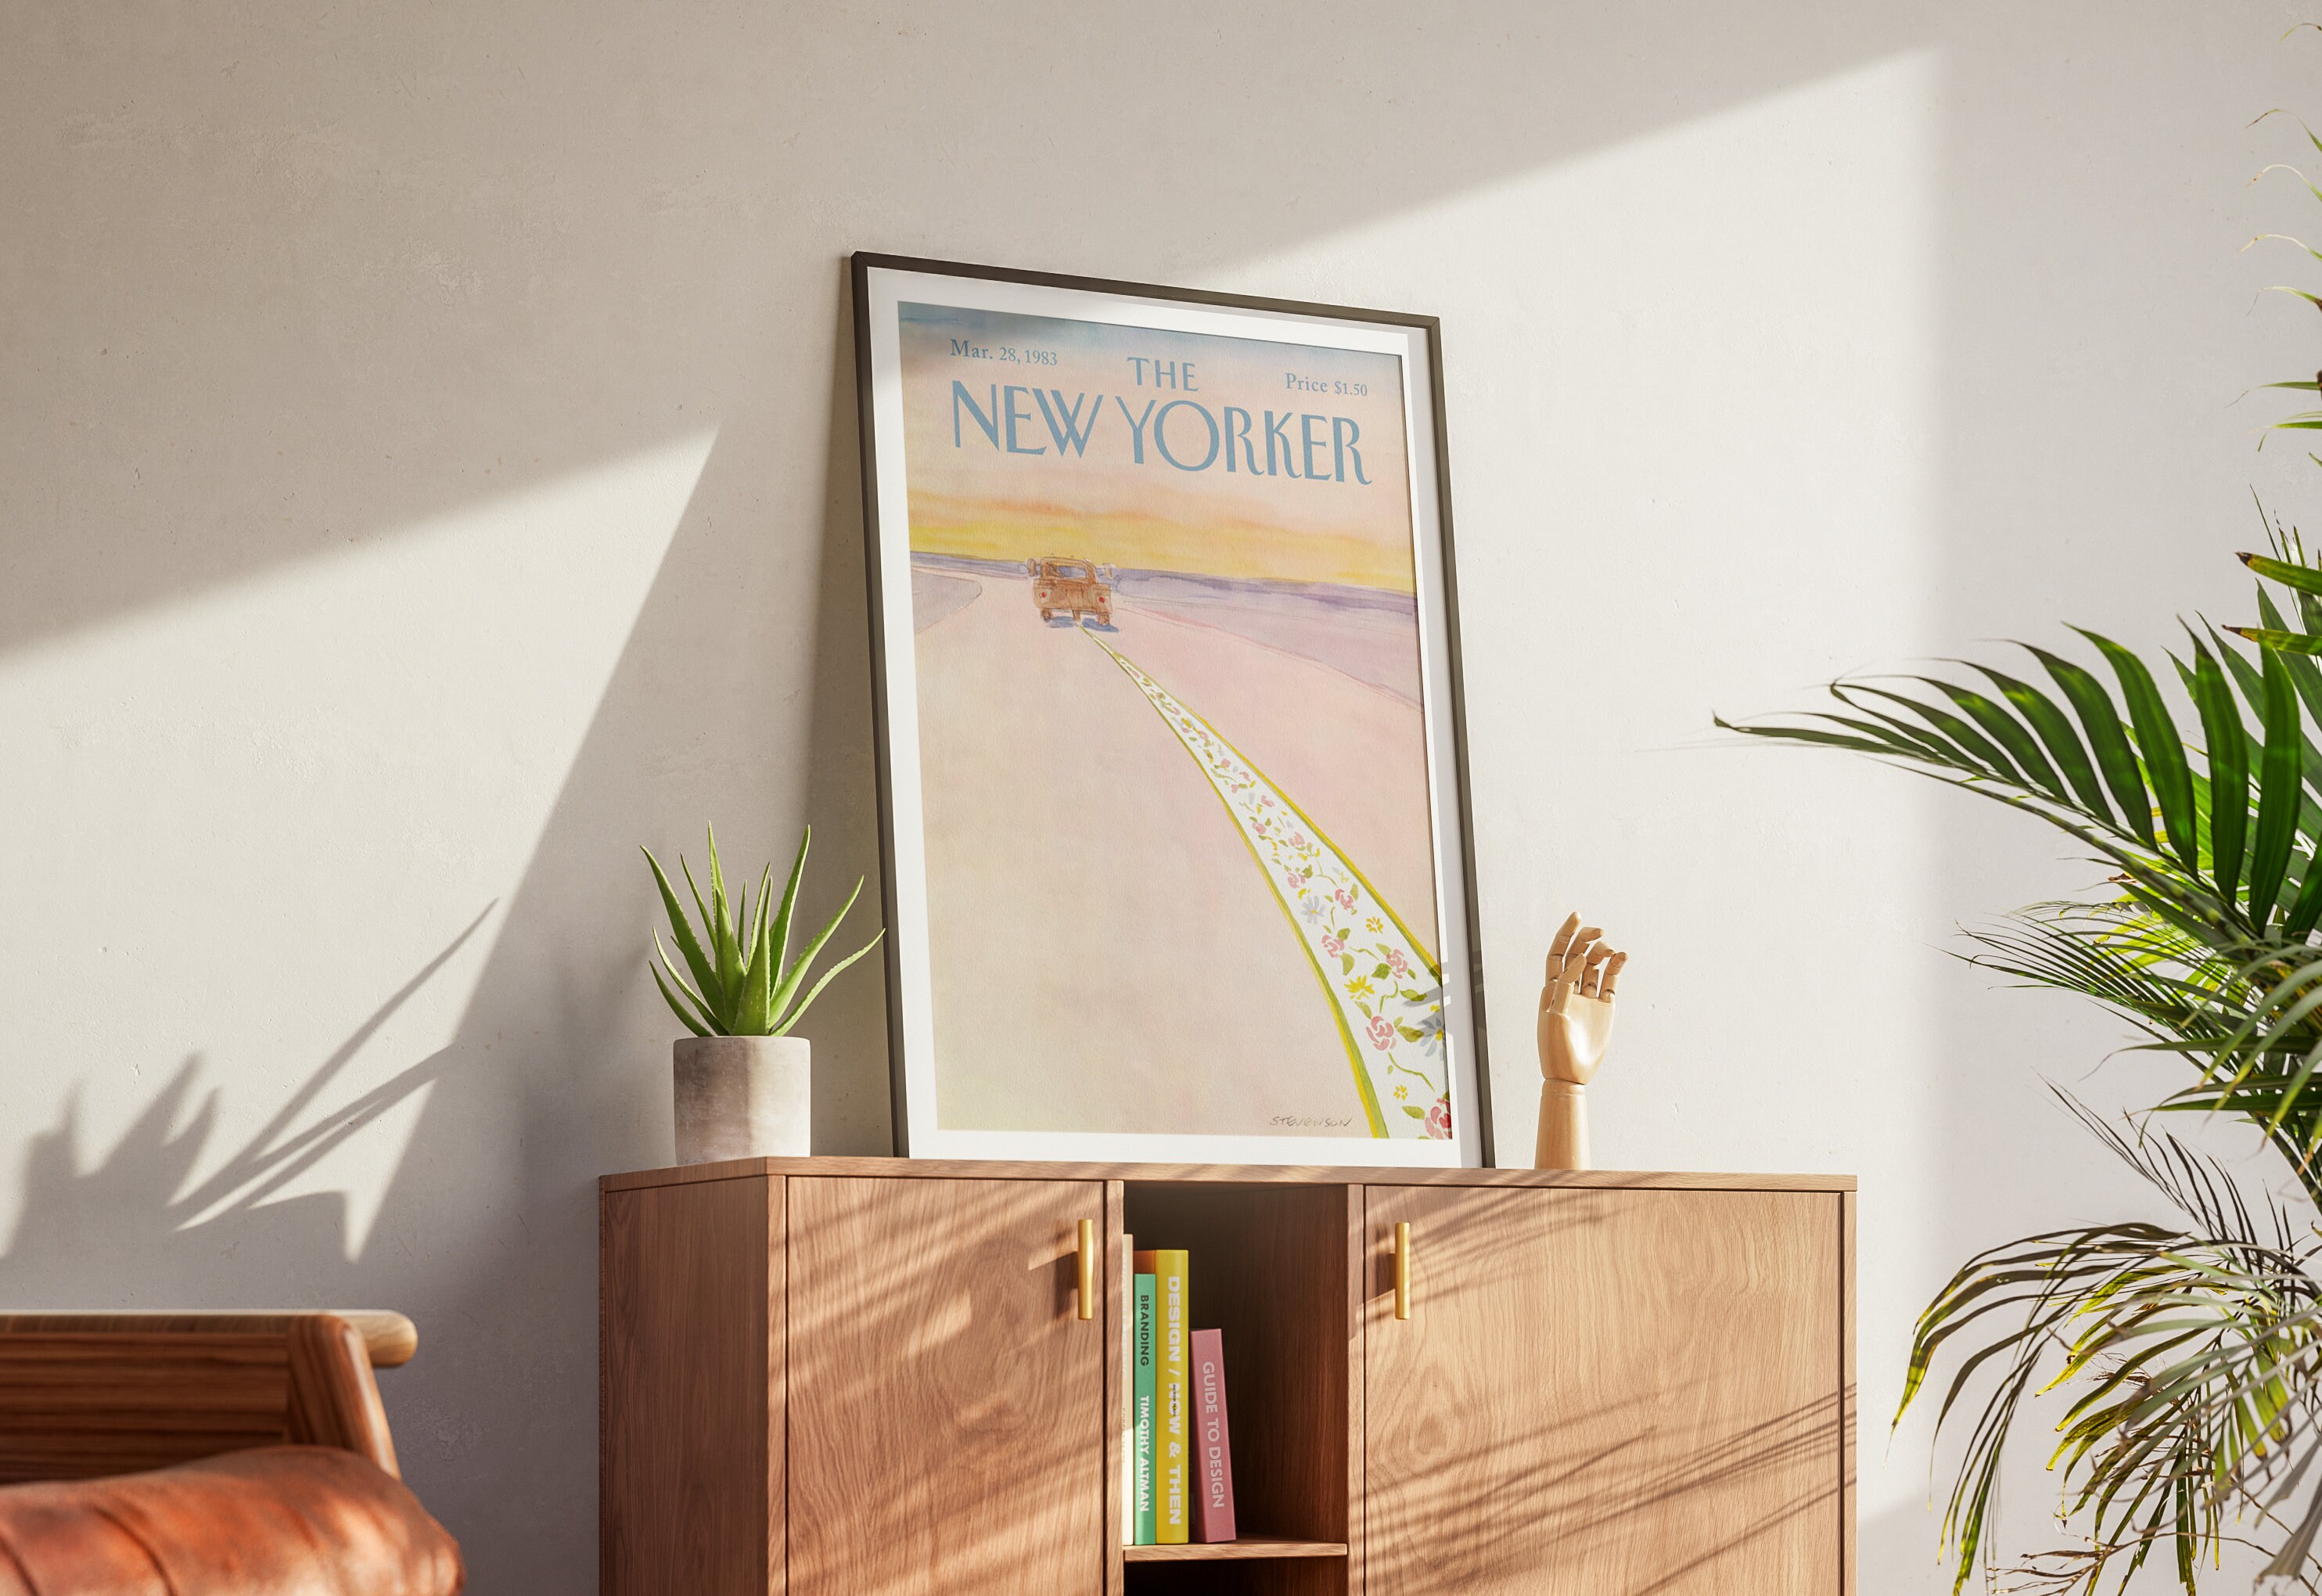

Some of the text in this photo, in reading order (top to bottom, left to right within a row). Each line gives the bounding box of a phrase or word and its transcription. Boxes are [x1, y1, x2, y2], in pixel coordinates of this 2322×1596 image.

[950, 338, 994, 359] Mar.
[1025, 349, 1058, 365] 1983
[1127, 356, 1199, 391] THE
[1285, 372, 1368, 397] Price $1.50
[952, 380, 1373, 484] NEW YORKER
[1140, 1295, 1149, 1367] BRANDING
[1168, 1276, 1181, 1361] DESIGN
[1140, 1396, 1149, 1512] TIMOTHY ALTMAN
[1202, 1361, 1225, 1508] GUIDE TO DESIGN
[1169, 1465, 1181, 1525] THEN
